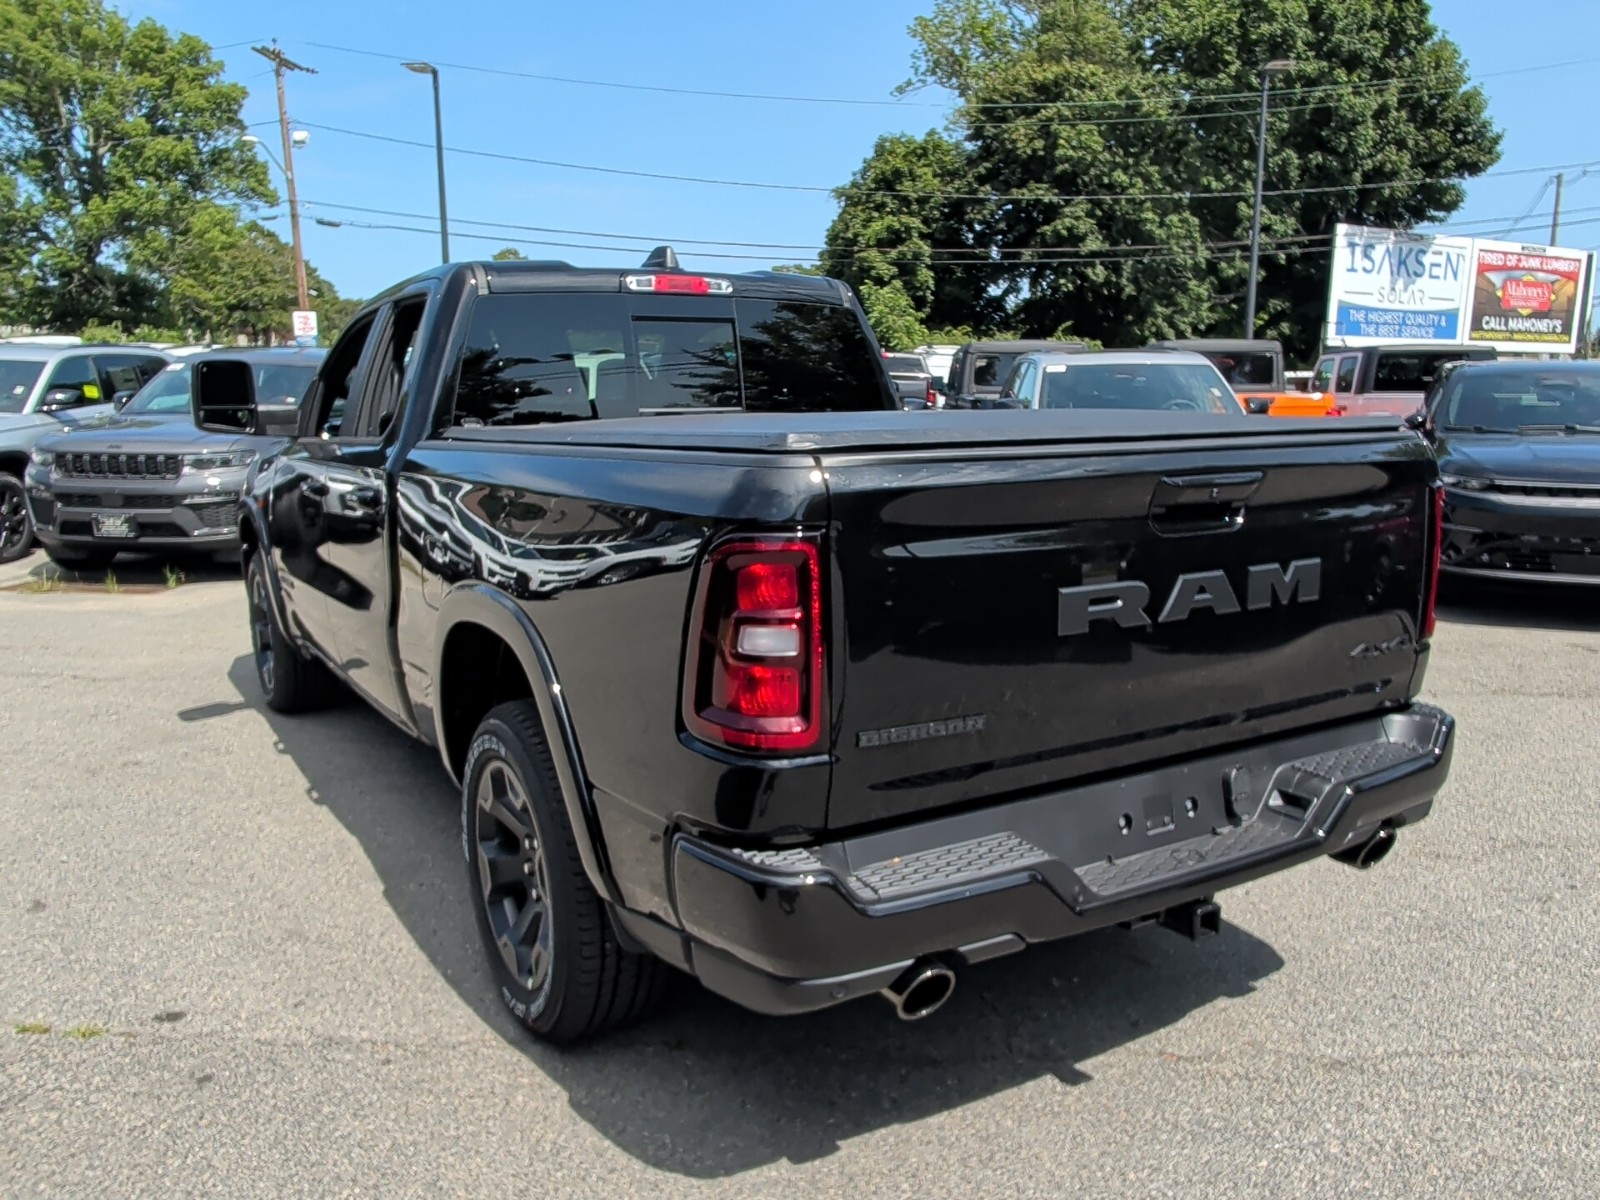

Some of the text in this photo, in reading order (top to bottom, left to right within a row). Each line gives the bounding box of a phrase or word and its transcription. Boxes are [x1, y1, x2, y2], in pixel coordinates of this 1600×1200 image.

[1346, 240, 1461, 281] ISAKSEN
[1479, 251, 1504, 266] TIRED
[1506, 254, 1519, 268] OF
[1519, 255, 1542, 270] JUNK
[1376, 286, 1425, 305] SOLAR
[1349, 309, 1366, 321] THE
[1367, 310, 1404, 325] HIGHEST
[1405, 312, 1439, 327] QUALITY
[1481, 315, 1507, 331] CALL
[1359, 322, 1436, 339] THE BEST SERVICE
[1058, 557, 1321, 636] RAM
